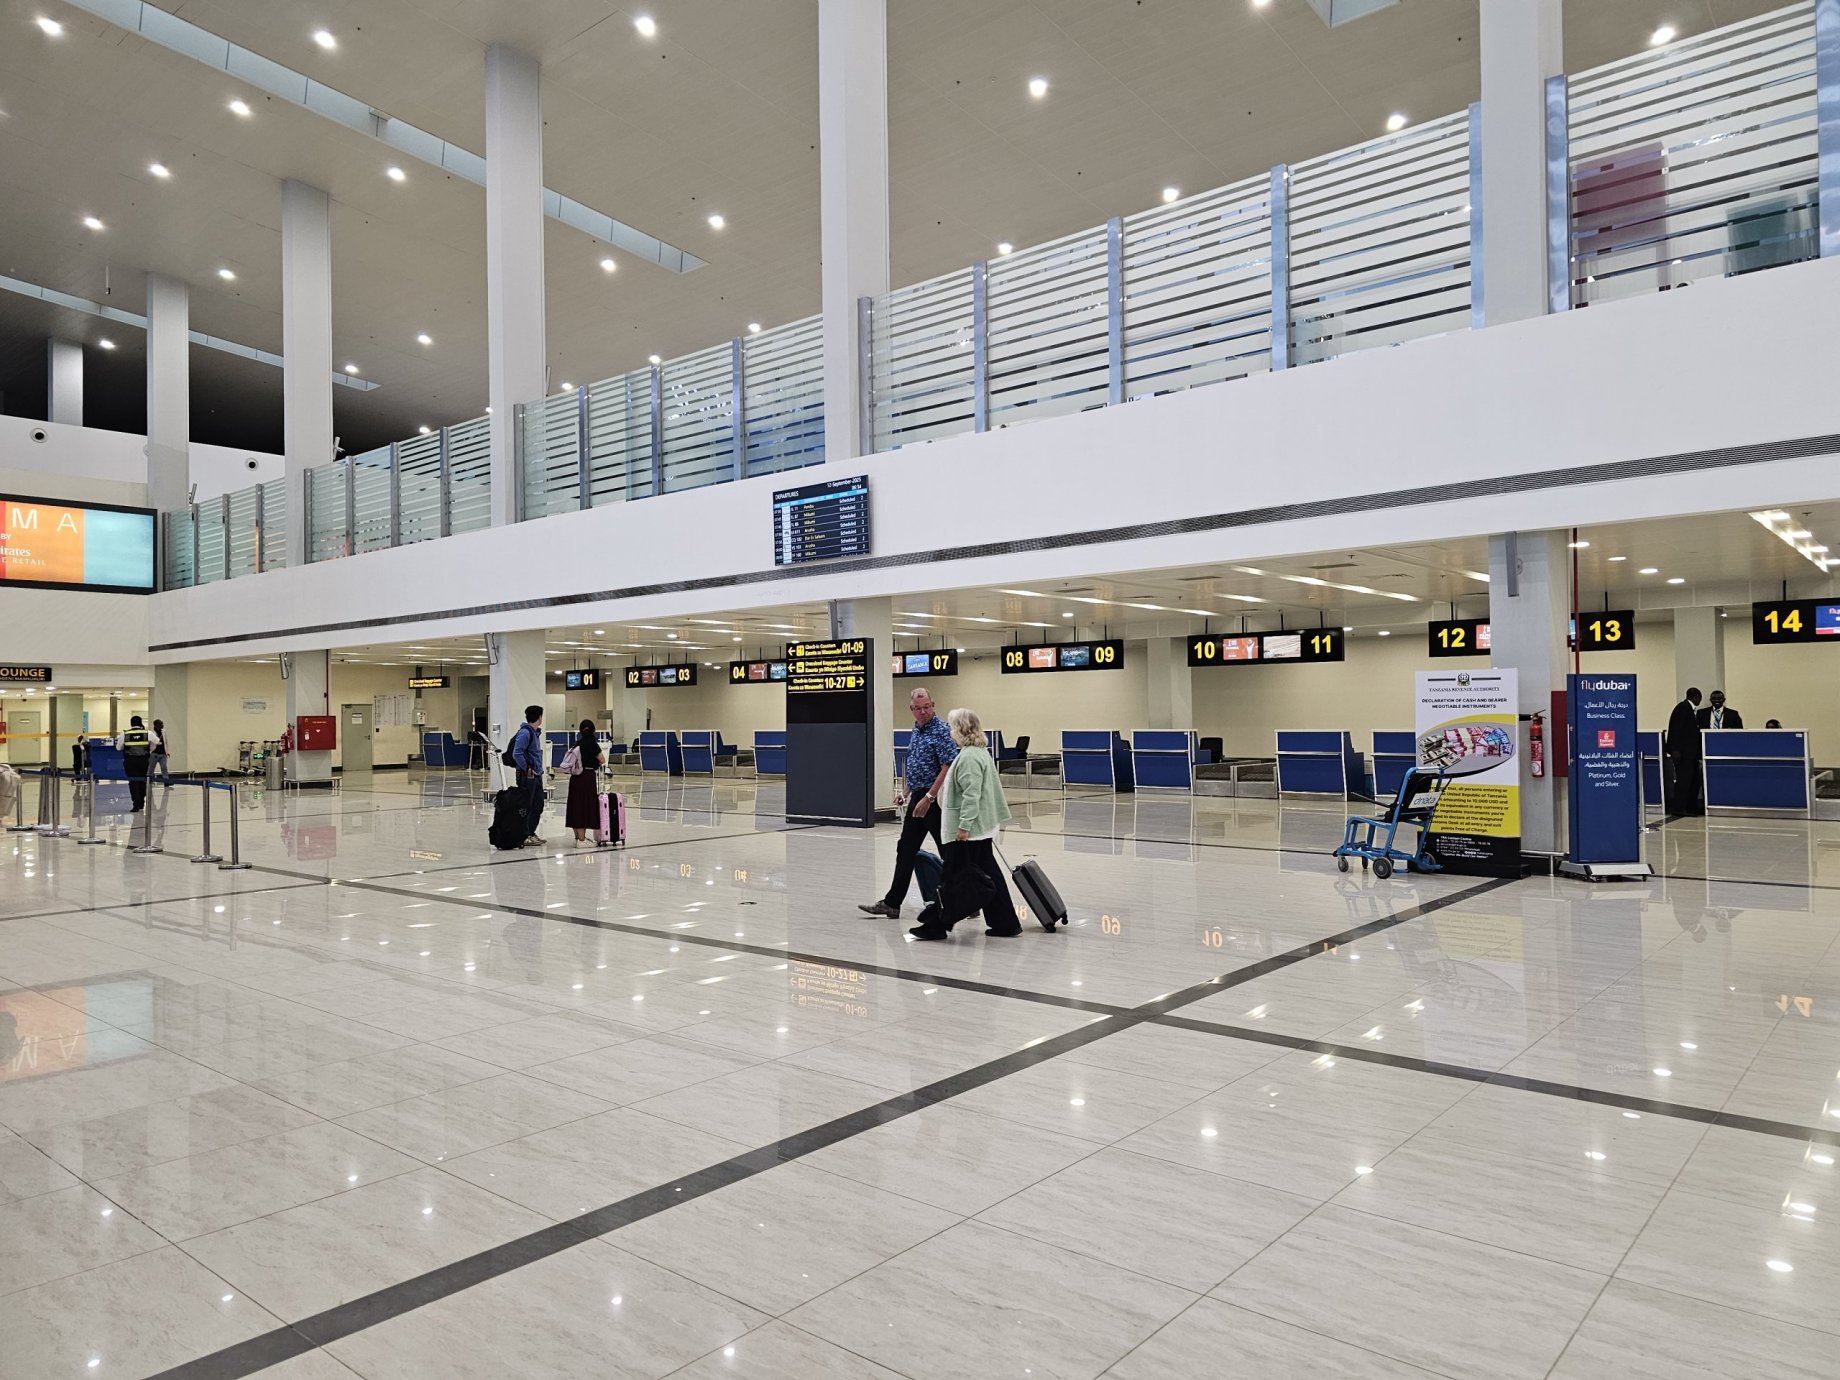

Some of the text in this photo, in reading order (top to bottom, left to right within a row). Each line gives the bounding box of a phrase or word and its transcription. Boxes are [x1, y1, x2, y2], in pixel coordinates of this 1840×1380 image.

[775, 490, 799, 500] DEPARTURES
[12, 557, 46, 566] RETAIL
[1764, 609, 1802, 634] 14
[1589, 620, 1622, 642] 13
[1311, 634, 1332, 654] 11
[1438, 628, 1465, 648] 12
[842, 641, 864, 654] 01-09
[1194, 641, 1215, 659] 10
[1006, 651, 1024, 668] 08
[1095, 646, 1115, 663] 09
[933, 655, 950, 670] 07
[629, 672, 639, 683] 02
[679, 669, 690, 681] 03
[733, 666, 745, 679] 04
[584, 674, 593, 685] 01
[825, 676, 846, 689] 10-27
[1581, 680, 1630, 691] flydubai
